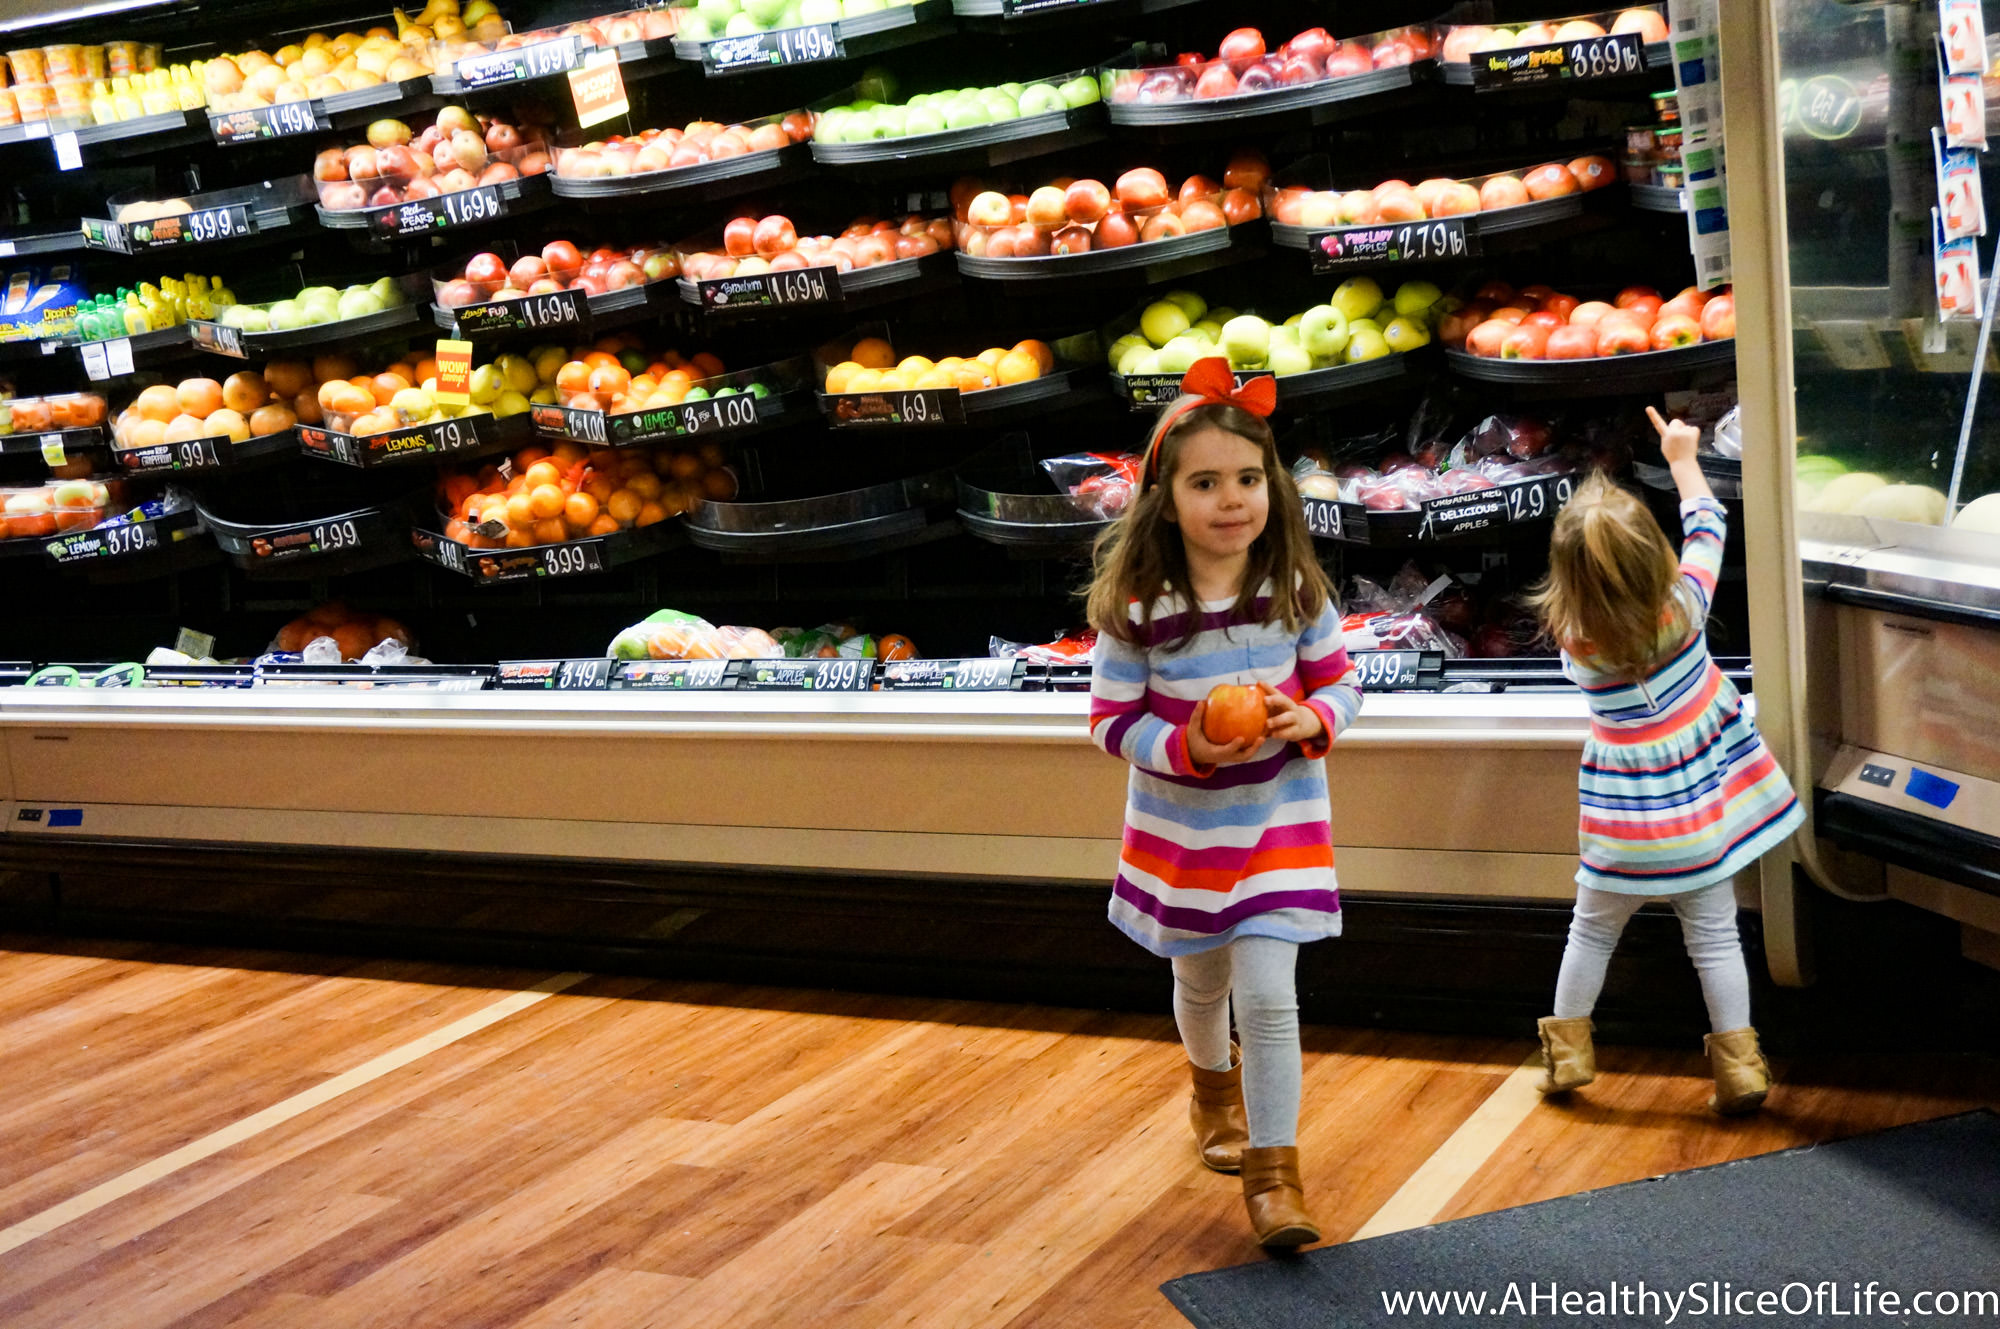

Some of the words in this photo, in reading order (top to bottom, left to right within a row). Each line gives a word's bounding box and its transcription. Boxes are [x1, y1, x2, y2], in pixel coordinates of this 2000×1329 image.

[781, 27, 820, 63] 1.49
[820, 34, 834, 58] lb
[527, 46, 562, 76] 1.69
[562, 44, 575, 70] lb
[1622, 46, 1637, 72] lb
[268, 104, 303, 136] 1.49
[301, 109, 315, 132] lb
[400, 203, 426, 217] Red
[400, 211, 435, 227] PEARS
[446, 190, 485, 225] 1.69
[485, 195, 498, 217] lb
[236, 225, 247, 233] EA
[1344, 231, 1369, 246] PINK
[1368, 229, 1394, 242] LADY
[1399, 222, 1447, 260] 2.79
[1449, 230, 1463, 256] lb
[1352, 241, 1388, 254] APPLES
[771, 272, 811, 304] 1.69
[811, 279, 823, 300] lb
[524, 295, 561, 328] 1.69
[562, 301, 575, 321] lb
[438, 359, 469, 375] WOW!
[568, 410, 578, 438] 2
[643, 410, 676, 431] LIMES
[684, 405, 700, 434] 3
[713, 396, 755, 428] 1.00
[155, 446, 169, 454] RED
[384, 434, 427, 452] LEMONS
[1439, 503, 1499, 522] DELICIOUS
[1452, 519, 1490, 533] APPLES
[68, 539, 101, 556] LEMONS
[107, 524, 144, 555] 3.79
[314, 520, 356, 550] 2.99
[545, 545, 585, 575] 3.99
[560, 661, 598, 689] 3.49
[595, 679, 605, 687] EA
[651, 673, 670, 683] BAG
[776, 668, 806, 682] APPLES
[814, 660, 857, 690] 3.99
[907, 660, 941, 672] GALA
[955, 659, 999, 689] 3.99
[997, 679, 1008, 687] EA
[1354, 653, 1401, 685] 3.99
[1400, 670, 1416, 684] pkg
